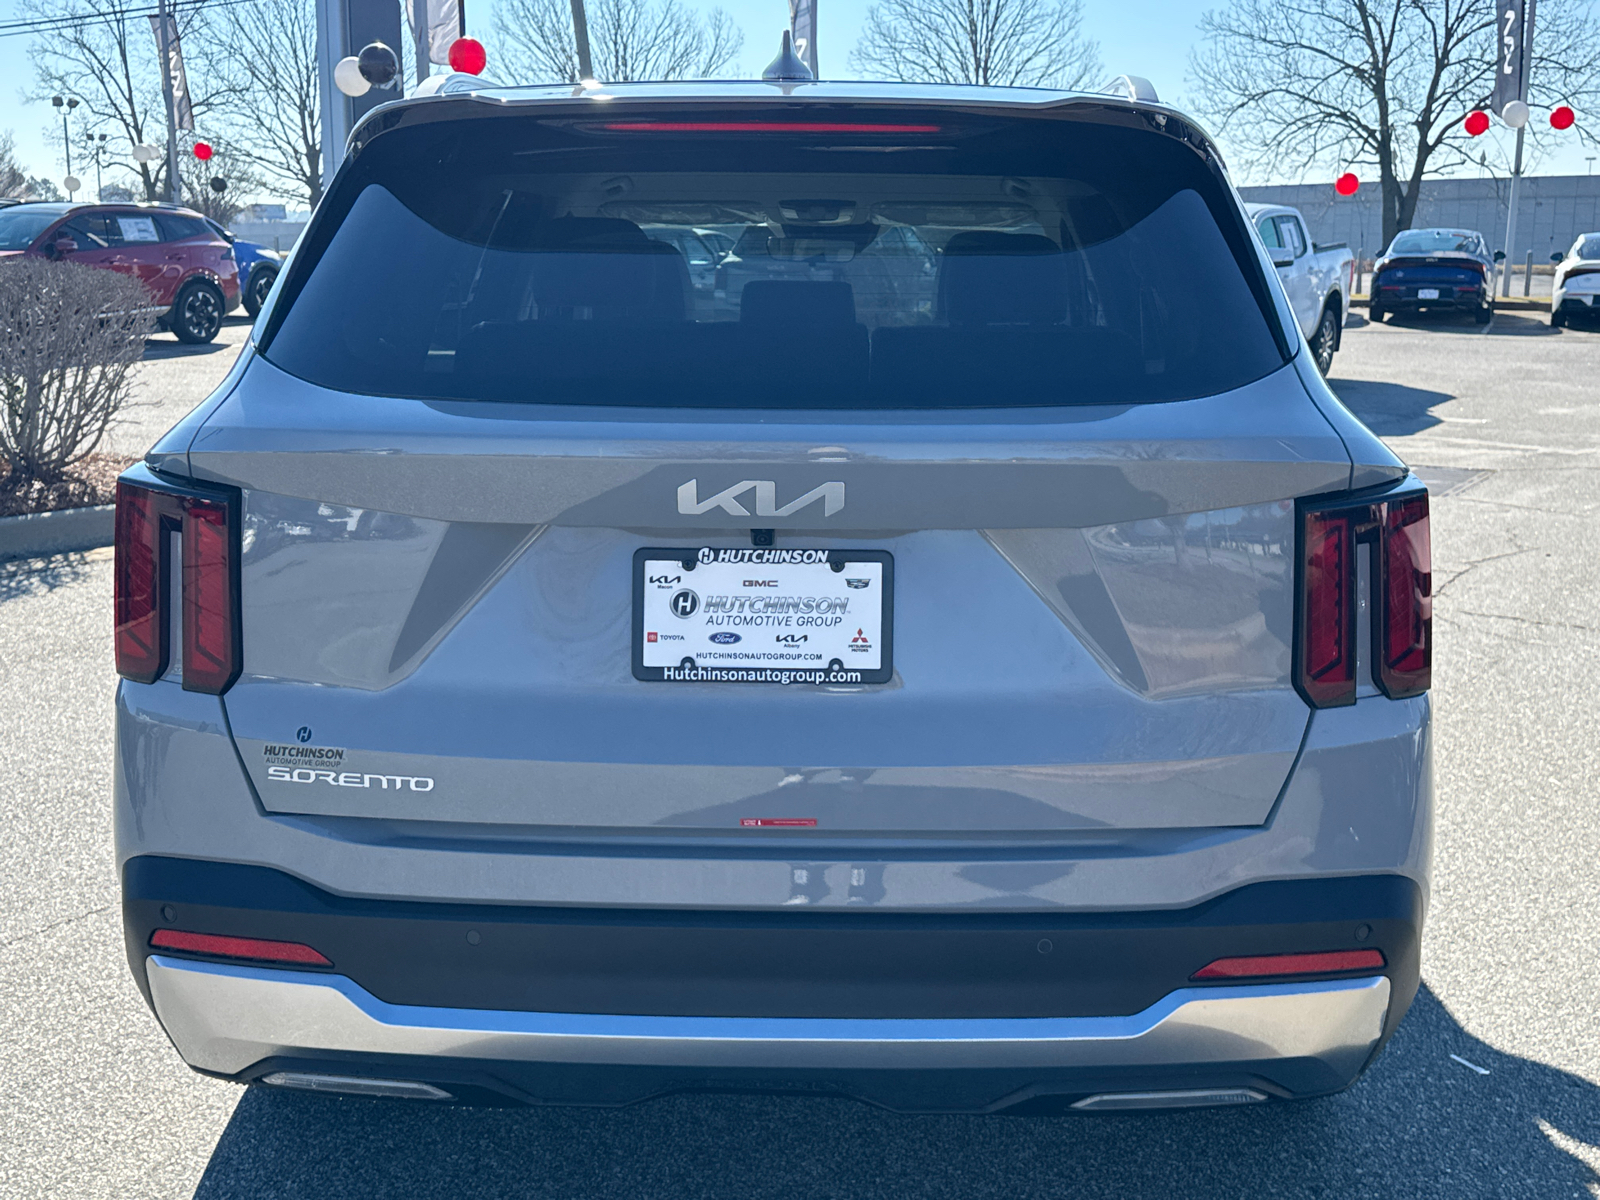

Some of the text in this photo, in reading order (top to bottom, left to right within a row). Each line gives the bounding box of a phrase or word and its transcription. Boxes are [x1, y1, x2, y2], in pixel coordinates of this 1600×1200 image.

[677, 479, 845, 517] KIA
[718, 549, 829, 564] HUTCHINSON
[649, 575, 682, 584] KIA
[703, 595, 850, 615] HUTCHINSON
[706, 615, 843, 627] AUTOMOTIVE GROUP
[714, 634, 736, 644] Ford
[775, 634, 808, 643] KIA
[696, 652, 823, 660] HUTCHINSONAUTOGROUP.COM
[663, 667, 862, 685] Hutchinsonautogroup.com
[264, 745, 344, 760] HUTCHINSON
[265, 757, 341, 768] AUTOMOTIVE GROUP
[267, 766, 435, 792] SORENTO
